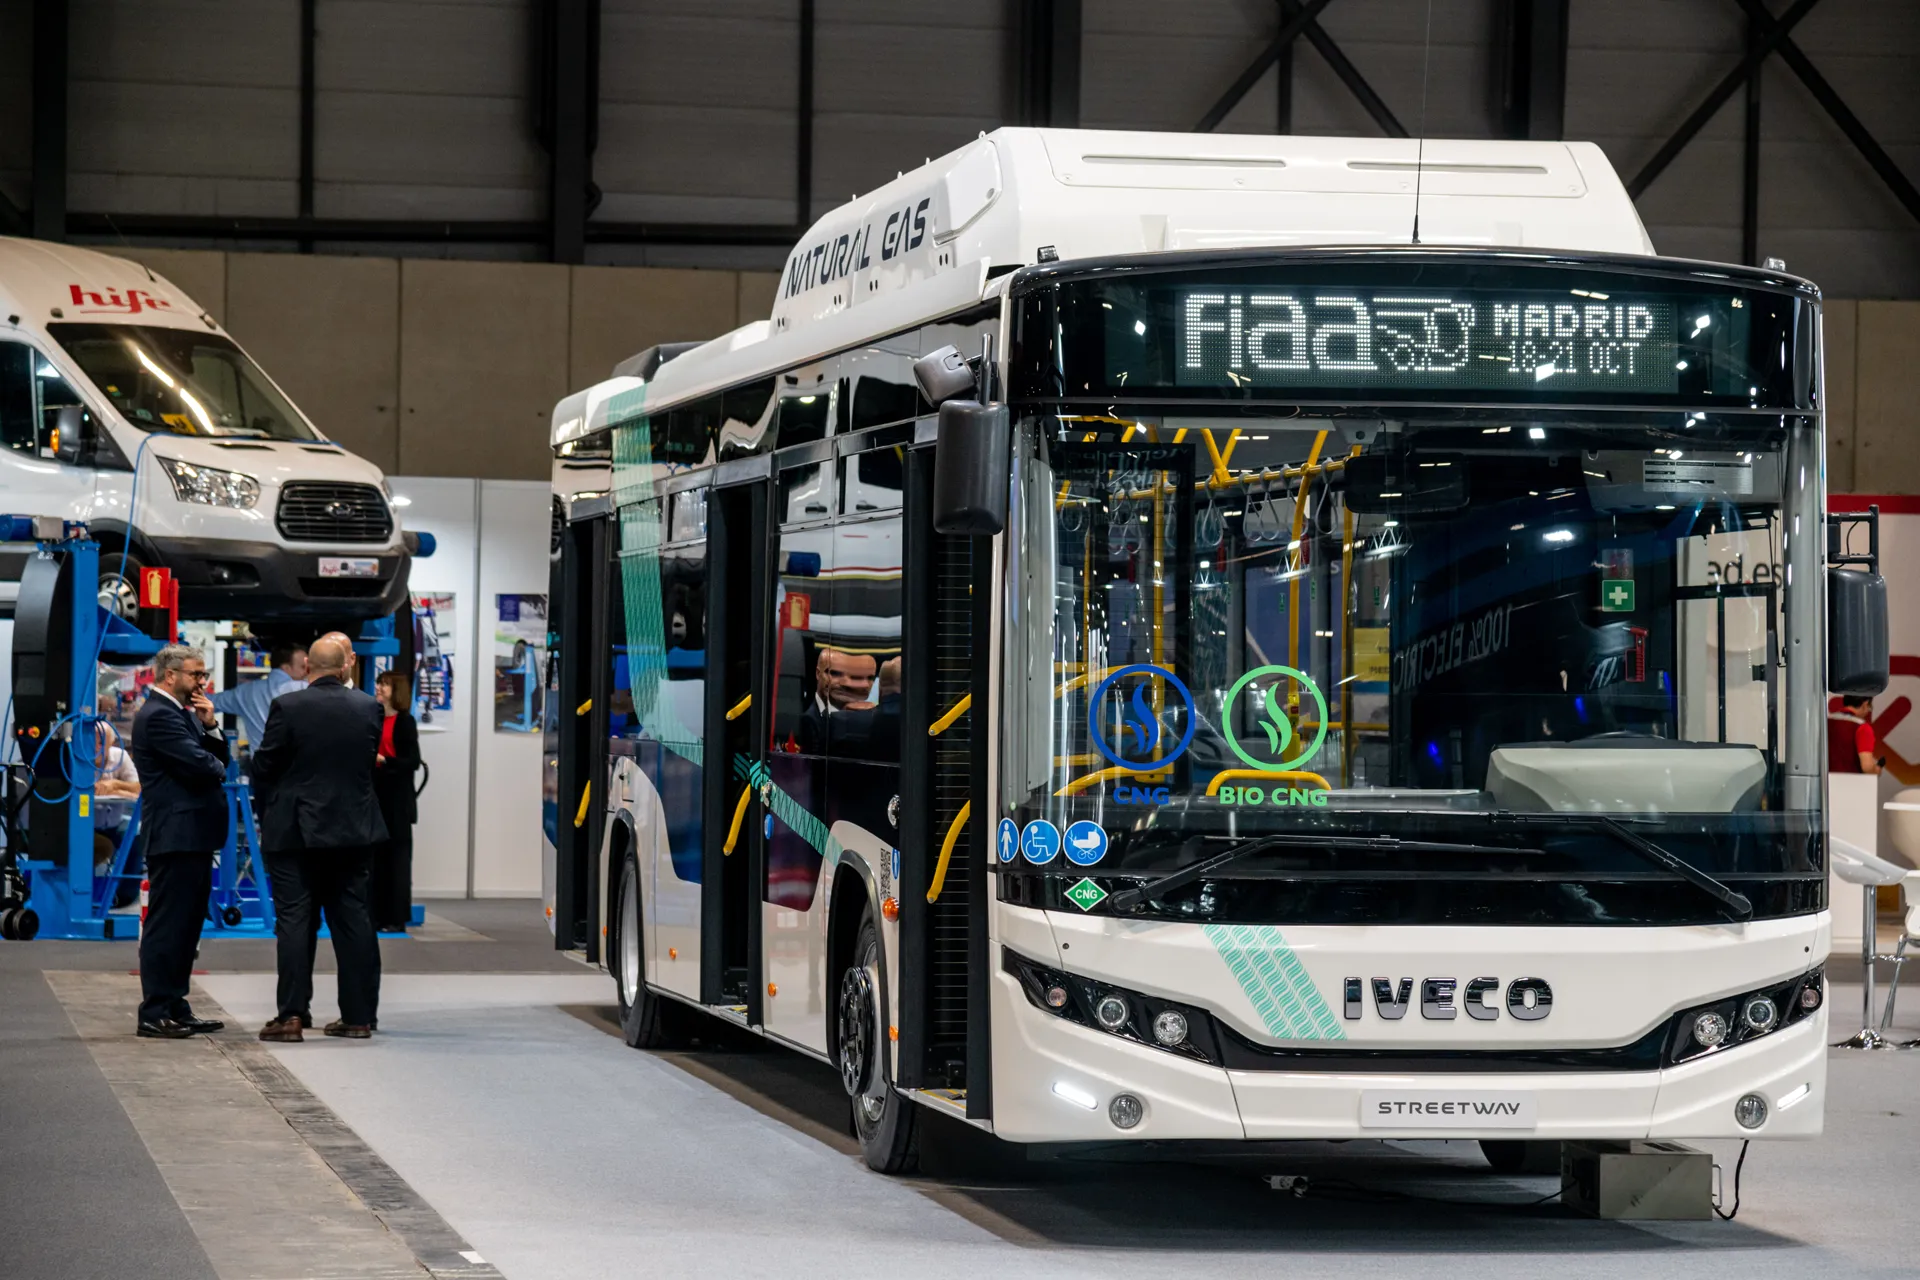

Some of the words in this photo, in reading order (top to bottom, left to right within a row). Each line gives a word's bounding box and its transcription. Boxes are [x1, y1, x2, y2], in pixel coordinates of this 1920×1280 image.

[785, 223, 871, 299] NATURAL
[881, 197, 930, 262] GAS
[1494, 304, 1653, 338] MADRID
[1508, 340, 1577, 373] 18-21
[1589, 341, 1640, 374] OCT
[1113, 786, 1169, 805] CNG
[1219, 786, 1265, 806] BIO
[1271, 788, 1328, 807] CNG
[1075, 889, 1098, 900] CNG
[1344, 976, 1553, 1021] IVECO
[1378, 1102, 1521, 1115] STREETWAY
